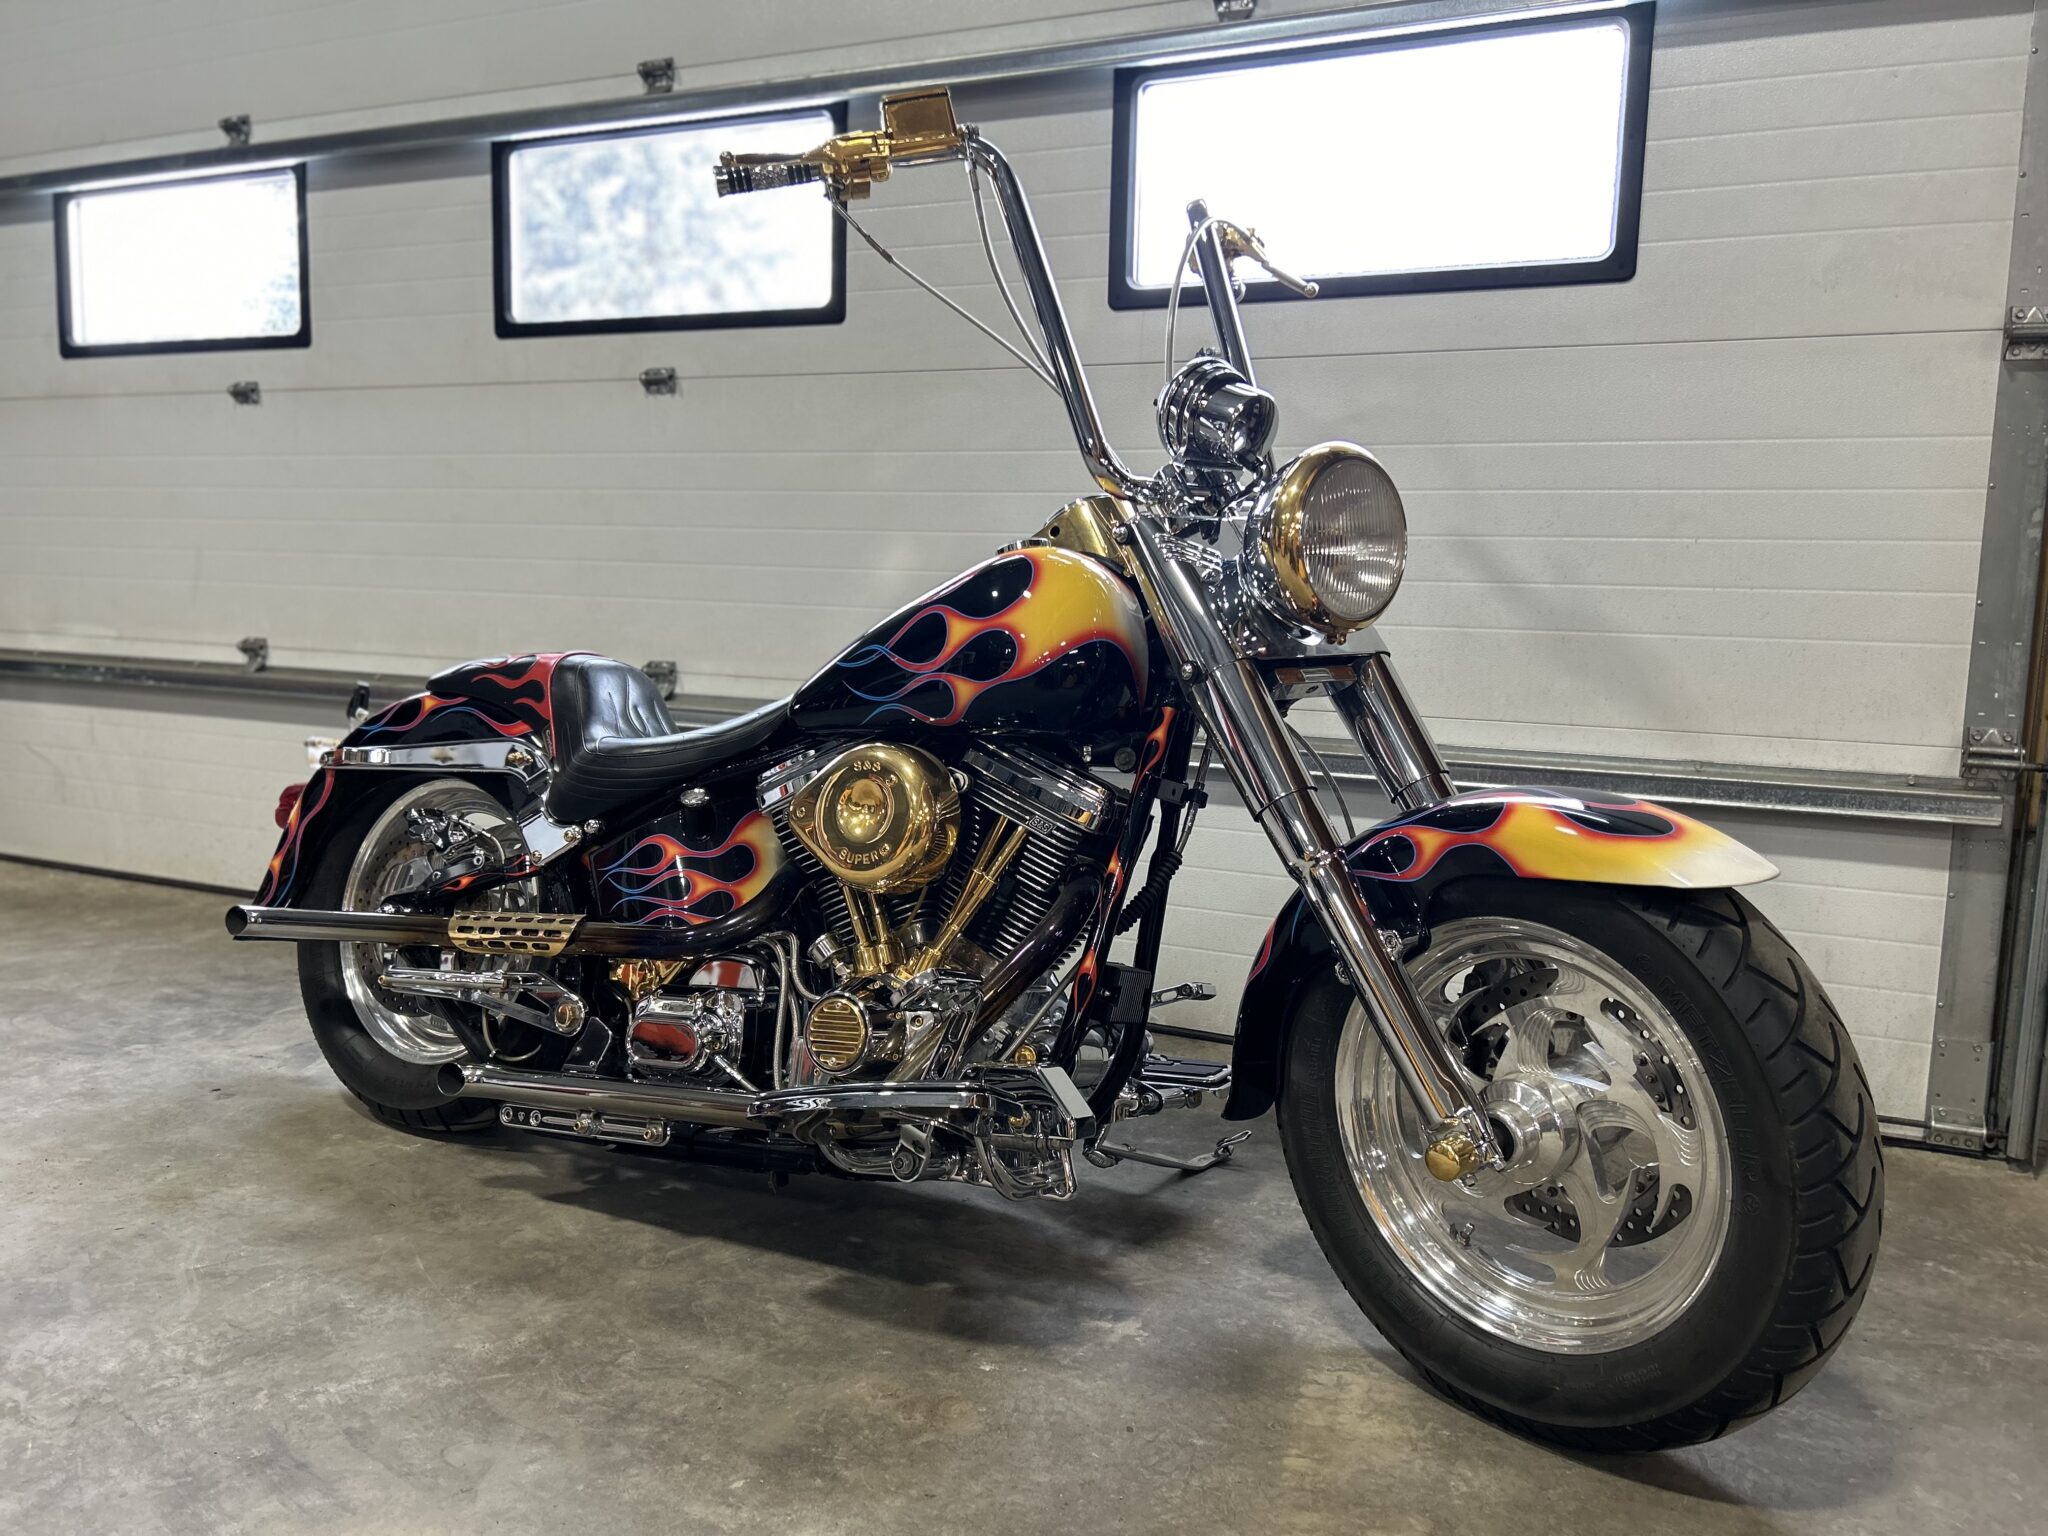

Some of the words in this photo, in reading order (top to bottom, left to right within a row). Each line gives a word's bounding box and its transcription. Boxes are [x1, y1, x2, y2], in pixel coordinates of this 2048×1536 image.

[853, 760, 881, 772] S&S
[1031, 818, 1050, 832] S&S
[838, 849, 879, 865] SUPER
